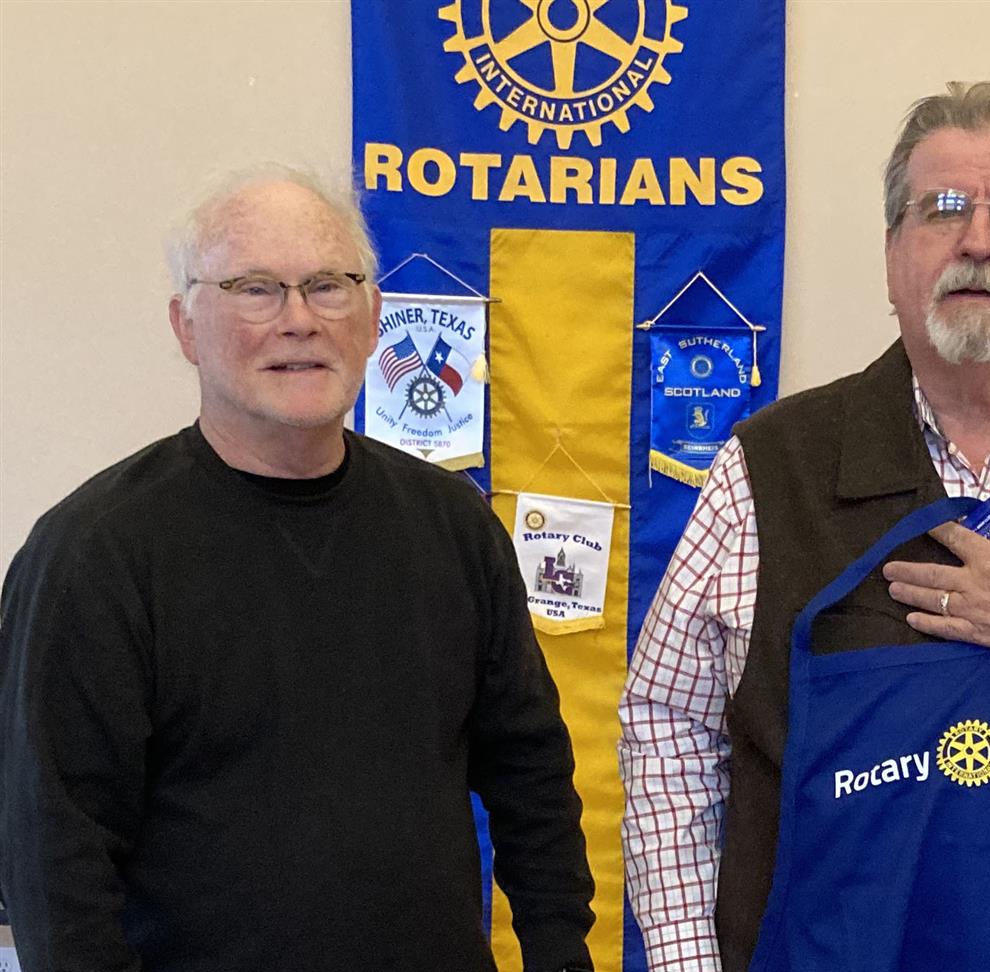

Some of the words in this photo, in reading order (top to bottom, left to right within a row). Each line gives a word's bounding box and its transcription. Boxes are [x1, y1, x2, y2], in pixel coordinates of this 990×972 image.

[475, 53, 654, 122] INTERNATIONAL
[364, 142, 764, 206] ROTARIANS
[431, 308, 476, 341] TEXAS
[656, 349, 673, 383] EAST
[678, 336, 748, 385] SUTHERLAND
[664, 387, 741, 398] SCOTLAND
[376, 406, 398, 429] Unity
[402, 423, 443, 438] Freedom
[447, 413, 474, 434] Justice
[400, 439, 432, 447] DISTRICT
[523, 531, 570, 543] Rotary
[573, 534, 603, 552] Club
[546, 608, 566, 618] USA
[571, 602, 602, 613] Texas
